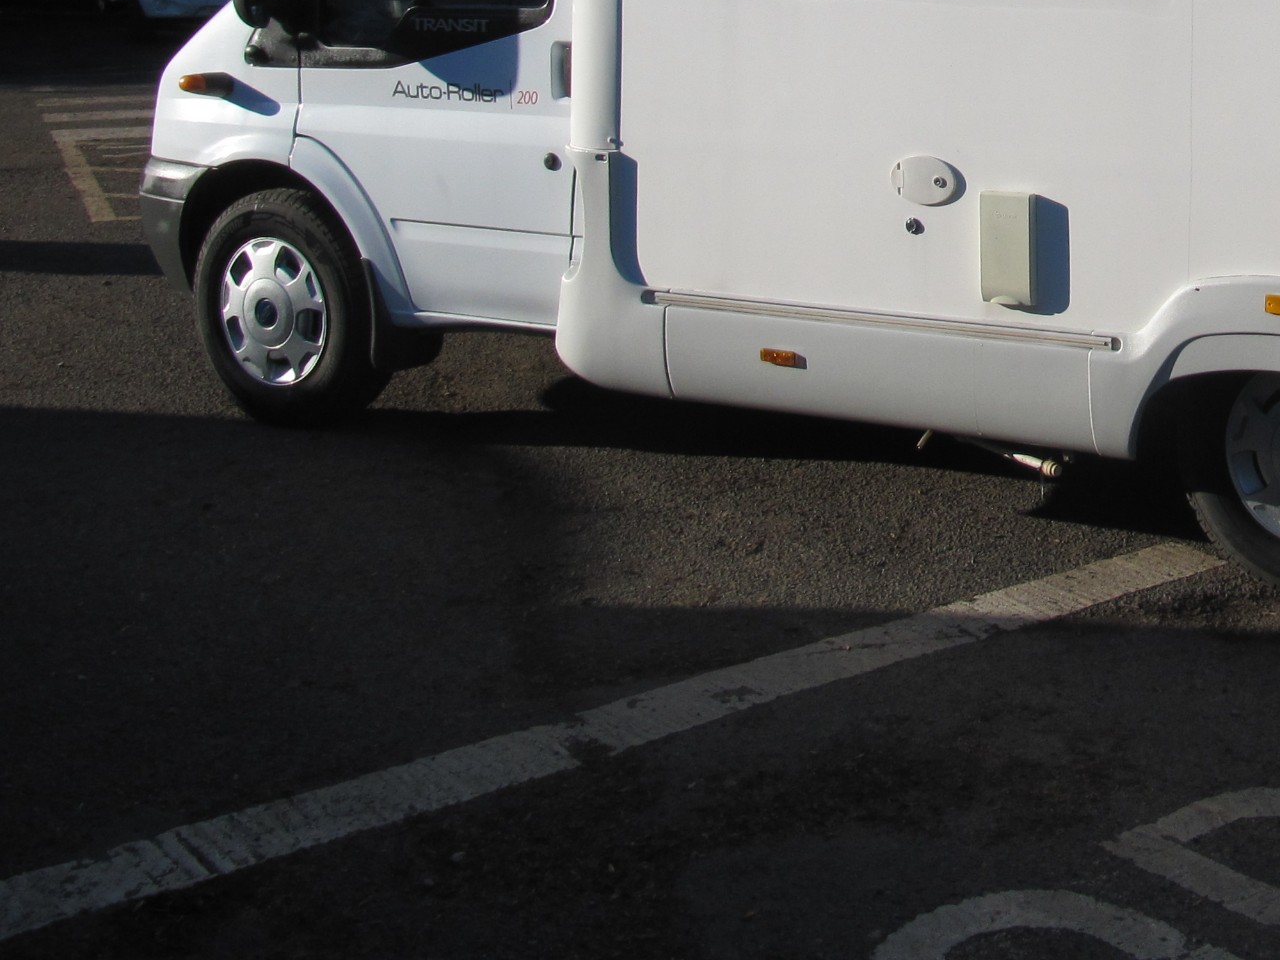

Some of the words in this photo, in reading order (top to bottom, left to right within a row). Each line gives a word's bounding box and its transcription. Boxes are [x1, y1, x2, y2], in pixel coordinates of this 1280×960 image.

[414, 18, 489, 32] TRANSIT
[392, 81, 504, 103] Auto-Roller
[517, 91, 538, 104] 200
